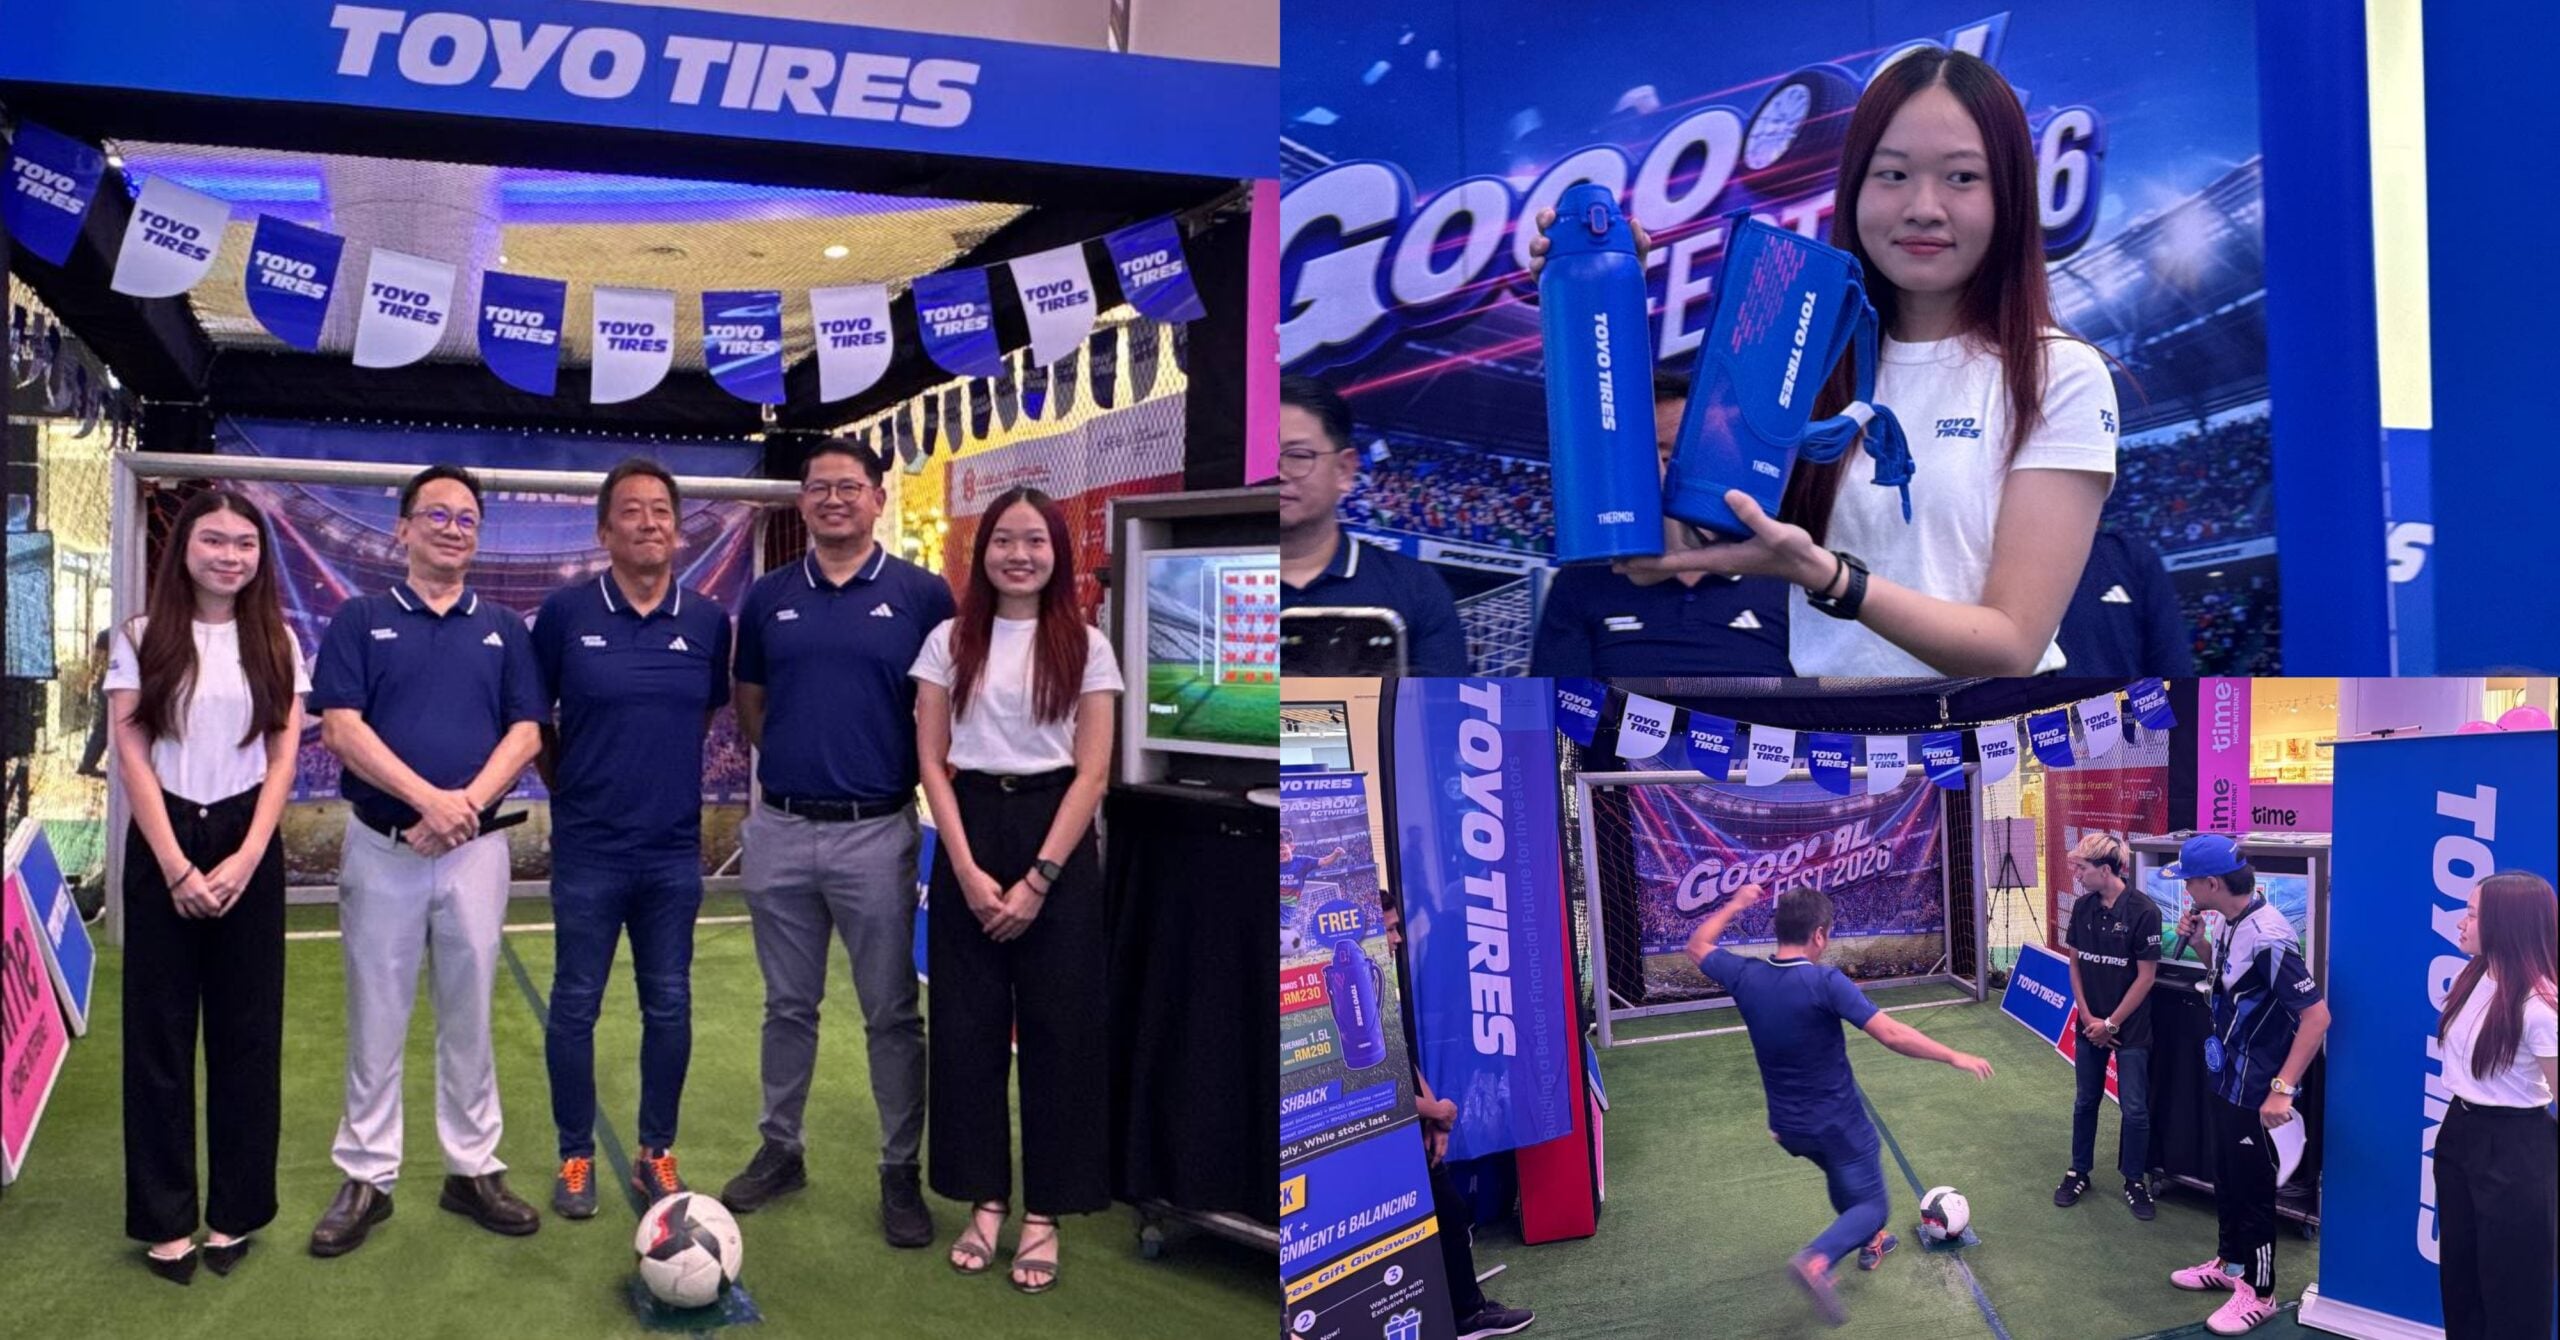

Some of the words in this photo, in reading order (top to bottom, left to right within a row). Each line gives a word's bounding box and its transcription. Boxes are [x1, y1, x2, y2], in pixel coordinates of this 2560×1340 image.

[331, 4, 646, 99] TOYO
[663, 35, 980, 128] TIRES
[13, 157, 76, 193] TOYO
[16, 176, 85, 215] TIRES
[138, 209, 201, 241] TOYO
[143, 228, 211, 261] TIRES
[255, 250, 317, 280] TOYO
[1120, 250, 1169, 276] TOYO
[1130, 260, 1183, 288] TIRES
[261, 269, 328, 300] TIRES
[371, 283, 430, 306] TOYO
[1024, 280, 1074, 303] TOYO
[1036, 291, 1090, 314] TIRES
[378, 301, 443, 325] TIRES
[485, 305, 545, 327] TOYO
[922, 303, 975, 323] TOYO
[1794, 291, 1817, 346] TOYO
[492, 323, 557, 345] TIRES
[598, 321, 655, 336] TOYO
[708, 325, 764, 339] TOYO
[820, 318, 872, 335] TOYO
[933, 315, 989, 337] TIRES
[607, 337, 668, 352] TIRES
[718, 340, 781, 355] TIRES
[830, 331, 887, 348] TIRES
[1594, 312, 1612, 368] TOYO
[1778, 348, 1804, 409] TIRES
[1598, 369, 1616, 431] TIRES
[1935, 417, 1976, 429] TOYO
[1935, 427, 1982, 439] TIRES
[1752, 460, 1781, 478] THERMOS
[1597, 511, 1635, 525] THERMOS
[1557, 689, 1592, 707] TOYO
[2133, 691, 2158, 707] TOYO
[2138, 696, 2166, 713] TIRES
[1561, 700, 1598, 719] TIRES
[2084, 711, 2110, 726] TOYO
[2212, 681, 2232, 753] time
[1627, 712, 1661, 728] TOYO
[2090, 717, 2118, 732] TIRES
[1630, 723, 1667, 739] TIRES
[1690, 730, 1724, 744] TOYO
[2032, 728, 2059, 741] TOYO
[2038, 734, 2067, 748] TIRES
[1694, 740, 1730, 754] TIRES
[1752, 743, 1784, 754] TOYO
[1811, 750, 1843, 760] TOYO
[1925, 749, 1954, 759] TOYO
[1981, 740, 2008, 752] TOYO
[1986, 747, 2015, 758] TIRES
[1756, 752, 1790, 764] TIRES
[1816, 759, 1849, 769] TIRES
[1869, 752, 1898, 761] TOYO
[1874, 760, 1906, 769] TIRES
[1930, 757, 1960, 767] TIRES
[1458, 681, 1506, 863] TOYO
[1280, 781, 1303, 792] YO
[1305, 778, 1352, 790] TIRES
[1280, 799, 1358, 813] OADSHOW
[1508, 756, 1528, 836] Investors
[2210, 778, 2230, 830] ime
[1310, 807, 1360, 817] ACTIVITIES
[2251, 806, 2297, 826] time
[1515, 840, 1530, 865] for
[1831, 839, 1893, 887] 2026
[1520, 869, 1538, 923] Future
[1318, 909, 1361, 935] FREE
[1463, 871, 1517, 1057] TIRES
[1524, 927, 1543, 1003] Financial
[1299, 973, 1321, 987] 1.0L
[1284, 987, 1321, 1006] RM230
[2017, 974, 2039, 995] TOYO
[2038, 984, 2066, 1009] TIRES
[1280, 1037, 1308, 1051] THERMOS
[1309, 1029, 1331, 1044] 1.5L
[1533, 1007, 1547, 1055] Better
[1294, 1042, 1331, 1062] RM290
[1539, 1060, 1551, 1071] a
[1280, 1086, 1329, 1115] SHBACK
[1304, 1132, 1336, 1149] While
[1337, 1121, 1367, 1138] stock
[1369, 1113, 1391, 1127] last.
[1337, 1220, 1346, 1239] &
[1349, 1190, 1417, 1234] BALANCING
[1300, 1222, 1308, 1232] +
[1286, 1282, 1313, 1299] ree
[1318, 1265, 1346, 1284] Gift
[1350, 1226, 1427, 1268] Giveaway!
[1388, 1269, 1399, 1282] 3
[1369, 1297, 1388, 1310] Walk
[1389, 1288, 1408, 1301] away
[1409, 1279, 1424, 1292] with
[1371, 1300, 1404, 1319] Exclusive
[1405, 1286, 1425, 1302] Prize!
[1300, 1314, 1312, 1329] 2
